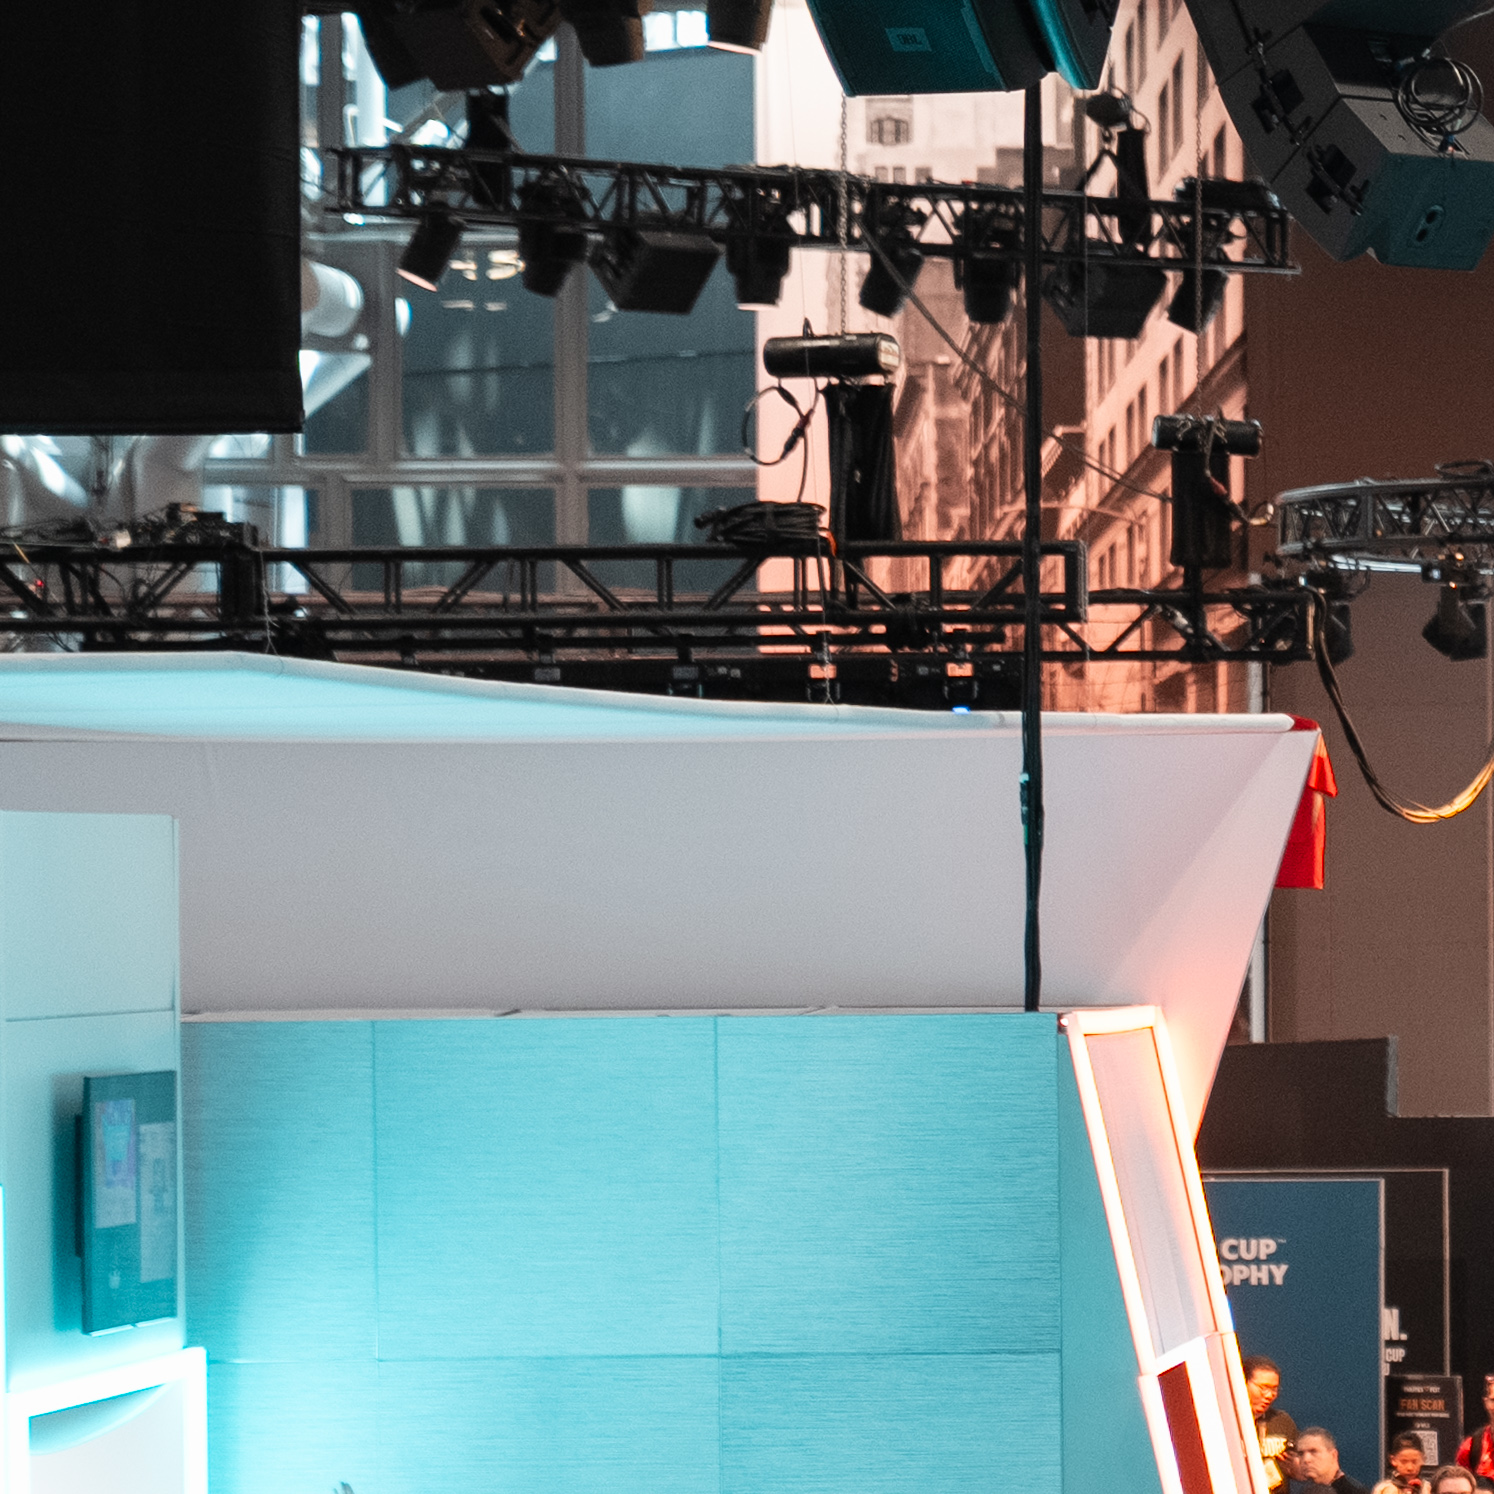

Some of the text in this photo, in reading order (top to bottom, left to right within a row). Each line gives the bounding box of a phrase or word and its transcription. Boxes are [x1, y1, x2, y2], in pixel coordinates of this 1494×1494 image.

[896, 33, 922, 45] JBL
[1400, 1399, 1445, 1412] FAN SCAN
